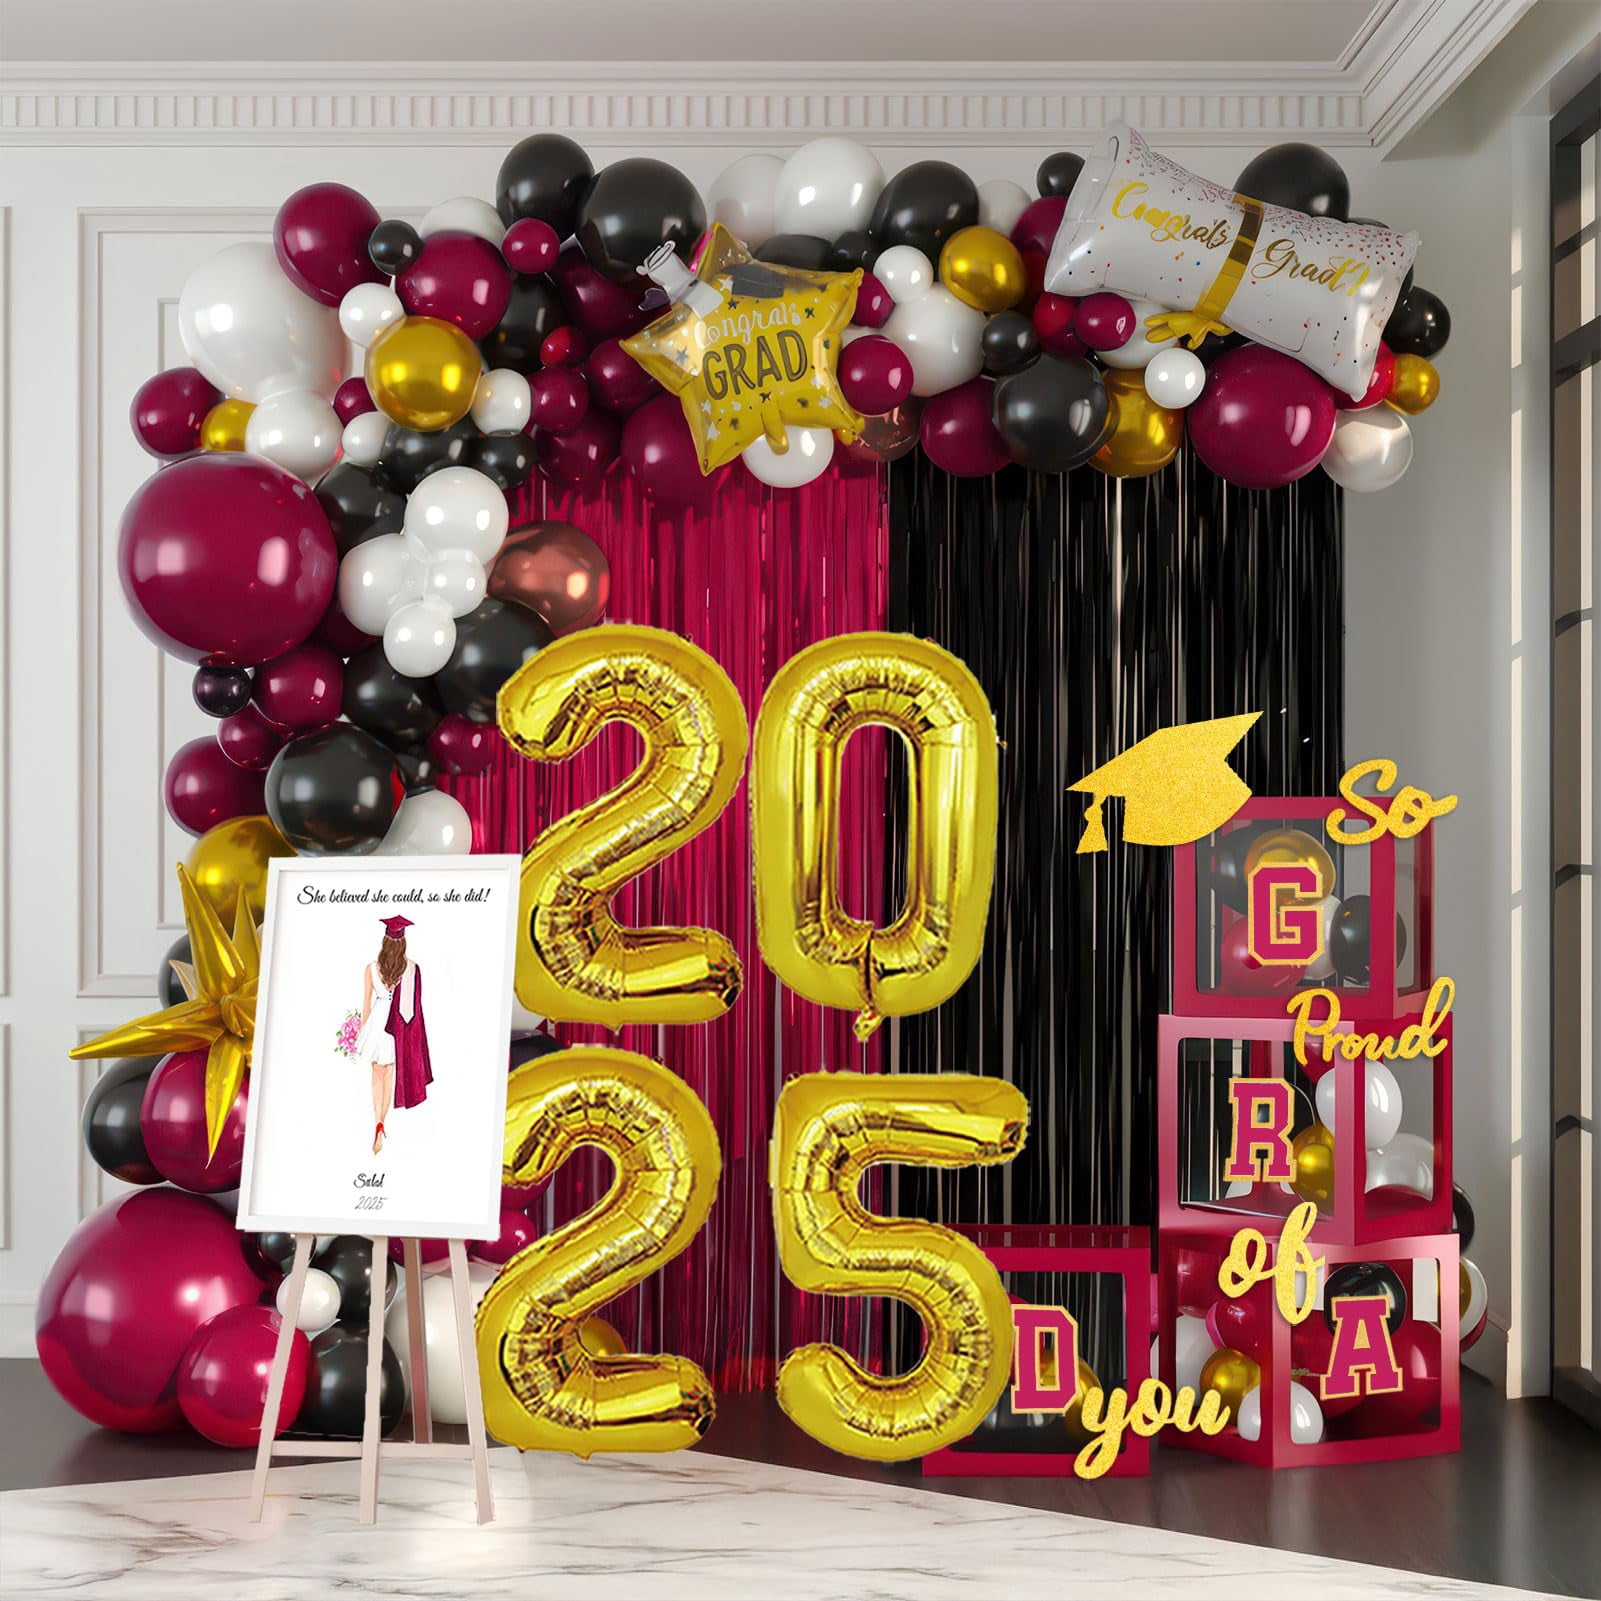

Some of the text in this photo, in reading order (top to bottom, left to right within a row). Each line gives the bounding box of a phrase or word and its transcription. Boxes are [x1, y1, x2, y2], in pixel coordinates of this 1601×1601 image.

[702, 329, 808, 401] GRAD
[1325, 758, 1458, 846] So
[296, 885, 492, 905] She believed she could, so she did!
[1247, 861, 1324, 966] G
[1286, 976, 1456, 1067] Proud
[1223, 1077, 1297, 1182] R
[354, 1195, 388, 1210] 2025
[1218, 1201, 1326, 1327] of
[1010, 1304, 1079, 1416] D
[1319, 1296, 1404, 1400] A
[1073, 1377, 1231, 1480] you
